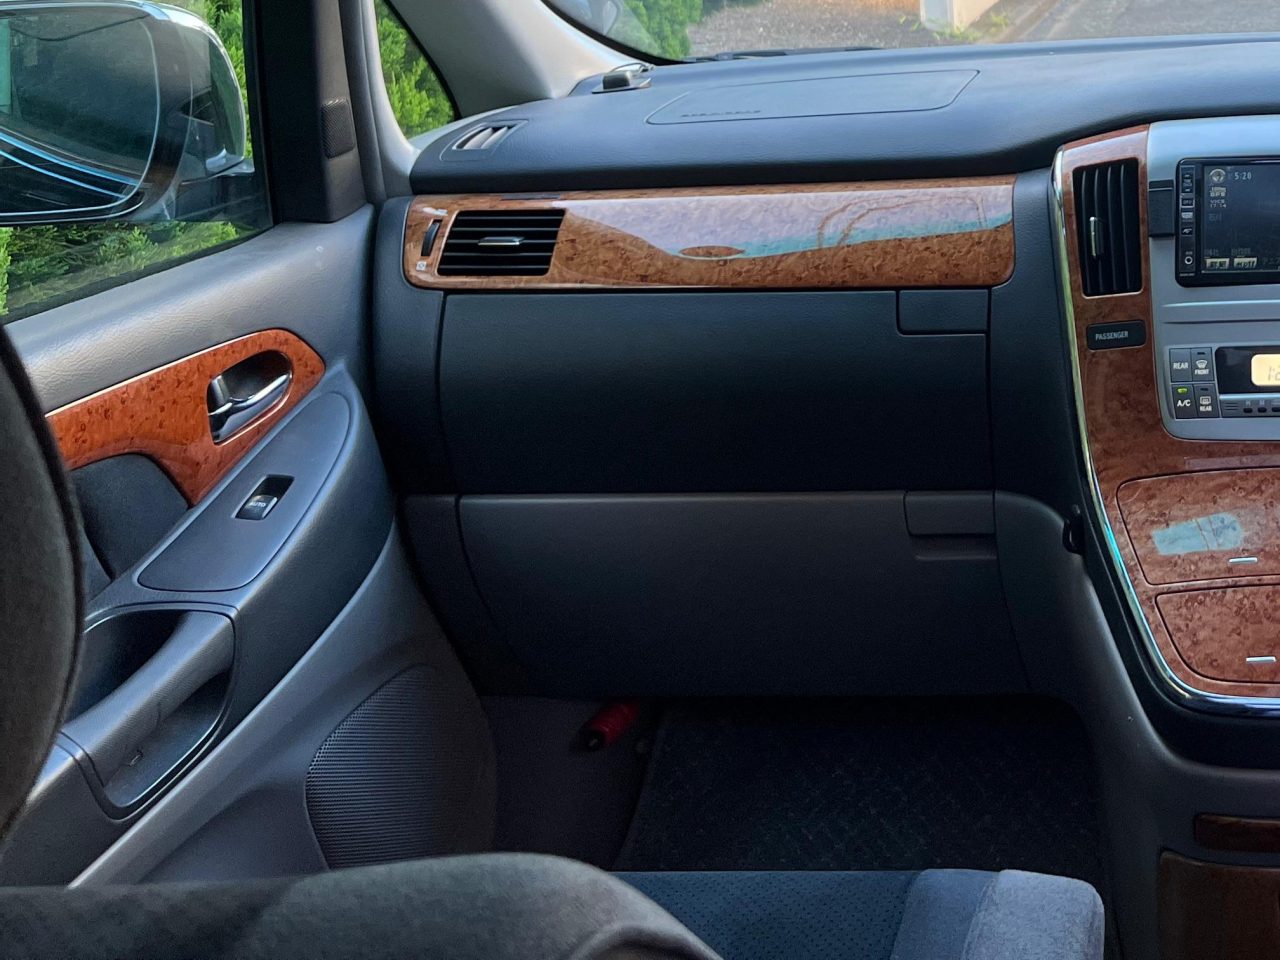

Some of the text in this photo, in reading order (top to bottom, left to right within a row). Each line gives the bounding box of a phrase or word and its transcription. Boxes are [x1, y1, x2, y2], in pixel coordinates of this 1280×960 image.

[1095, 331, 1129, 341] PASSENGER
[1173, 362, 1188, 370] REAR
[1177, 399, 1191, 407] A/C
